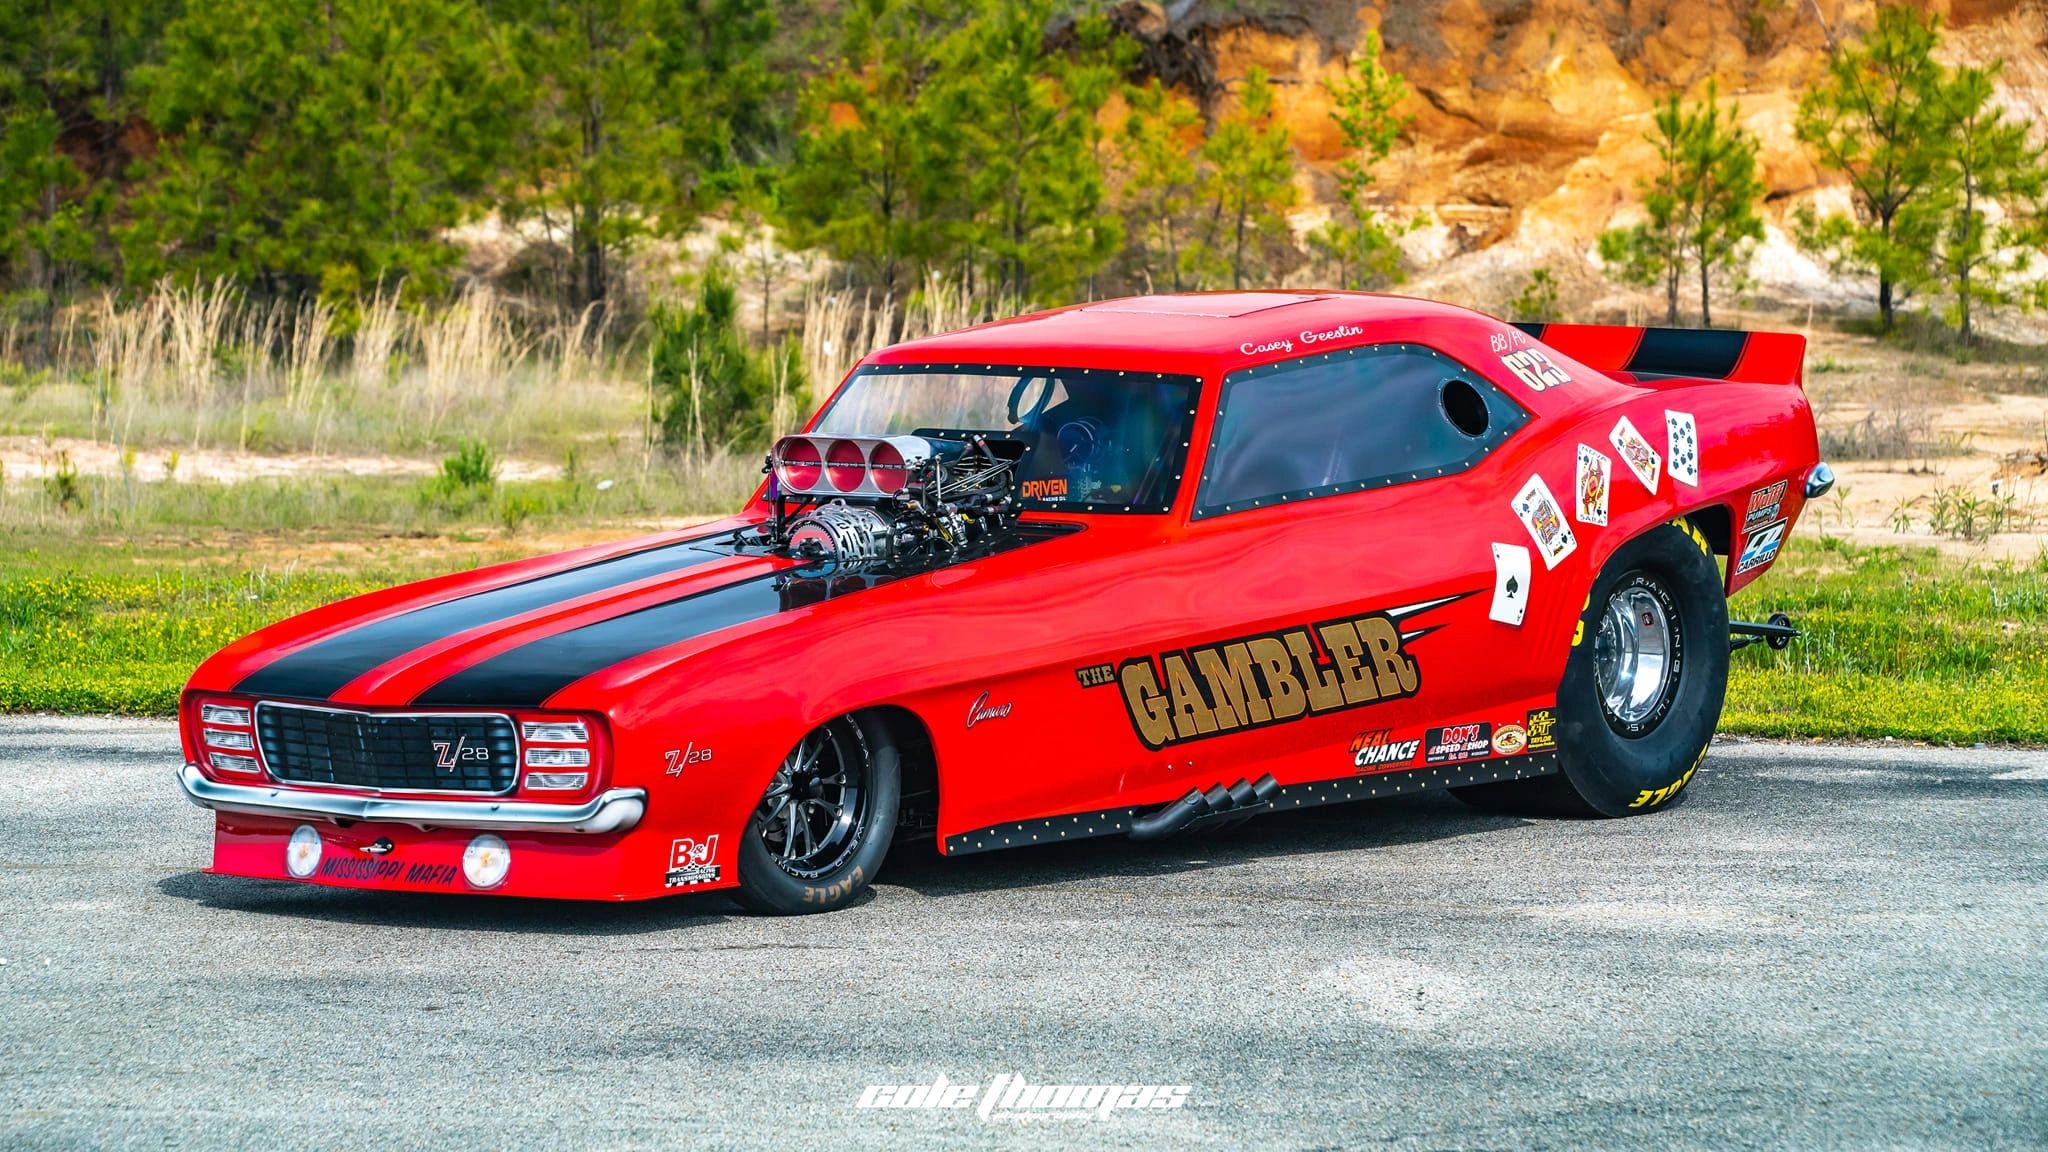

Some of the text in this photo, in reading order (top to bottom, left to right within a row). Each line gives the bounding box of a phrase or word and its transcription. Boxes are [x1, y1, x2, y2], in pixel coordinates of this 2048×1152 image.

[1240, 325, 1363, 356] Casey Geeslin
[1500, 347, 1572, 392] 623
[1022, 479, 1068, 501] DRIVEN
[1737, 549, 1776, 573] CARRILLO
[1076, 616, 1418, 746] THE GAMBLER
[1350, 729, 1392, 752] NEAL
[1436, 744, 1461, 754] SPEED
[1467, 740, 1489, 750] SHOP
[1441, 724, 1480, 745] DON'S
[433, 735, 489, 772] Z/28
[665, 741, 712, 777] Z/28
[1355, 740, 1420, 766] CHANCE
[669, 834, 719, 870] B&J
[321, 856, 458, 885] MISSISSIPPI MAFIA
[802, 865, 864, 904] EAGLE
